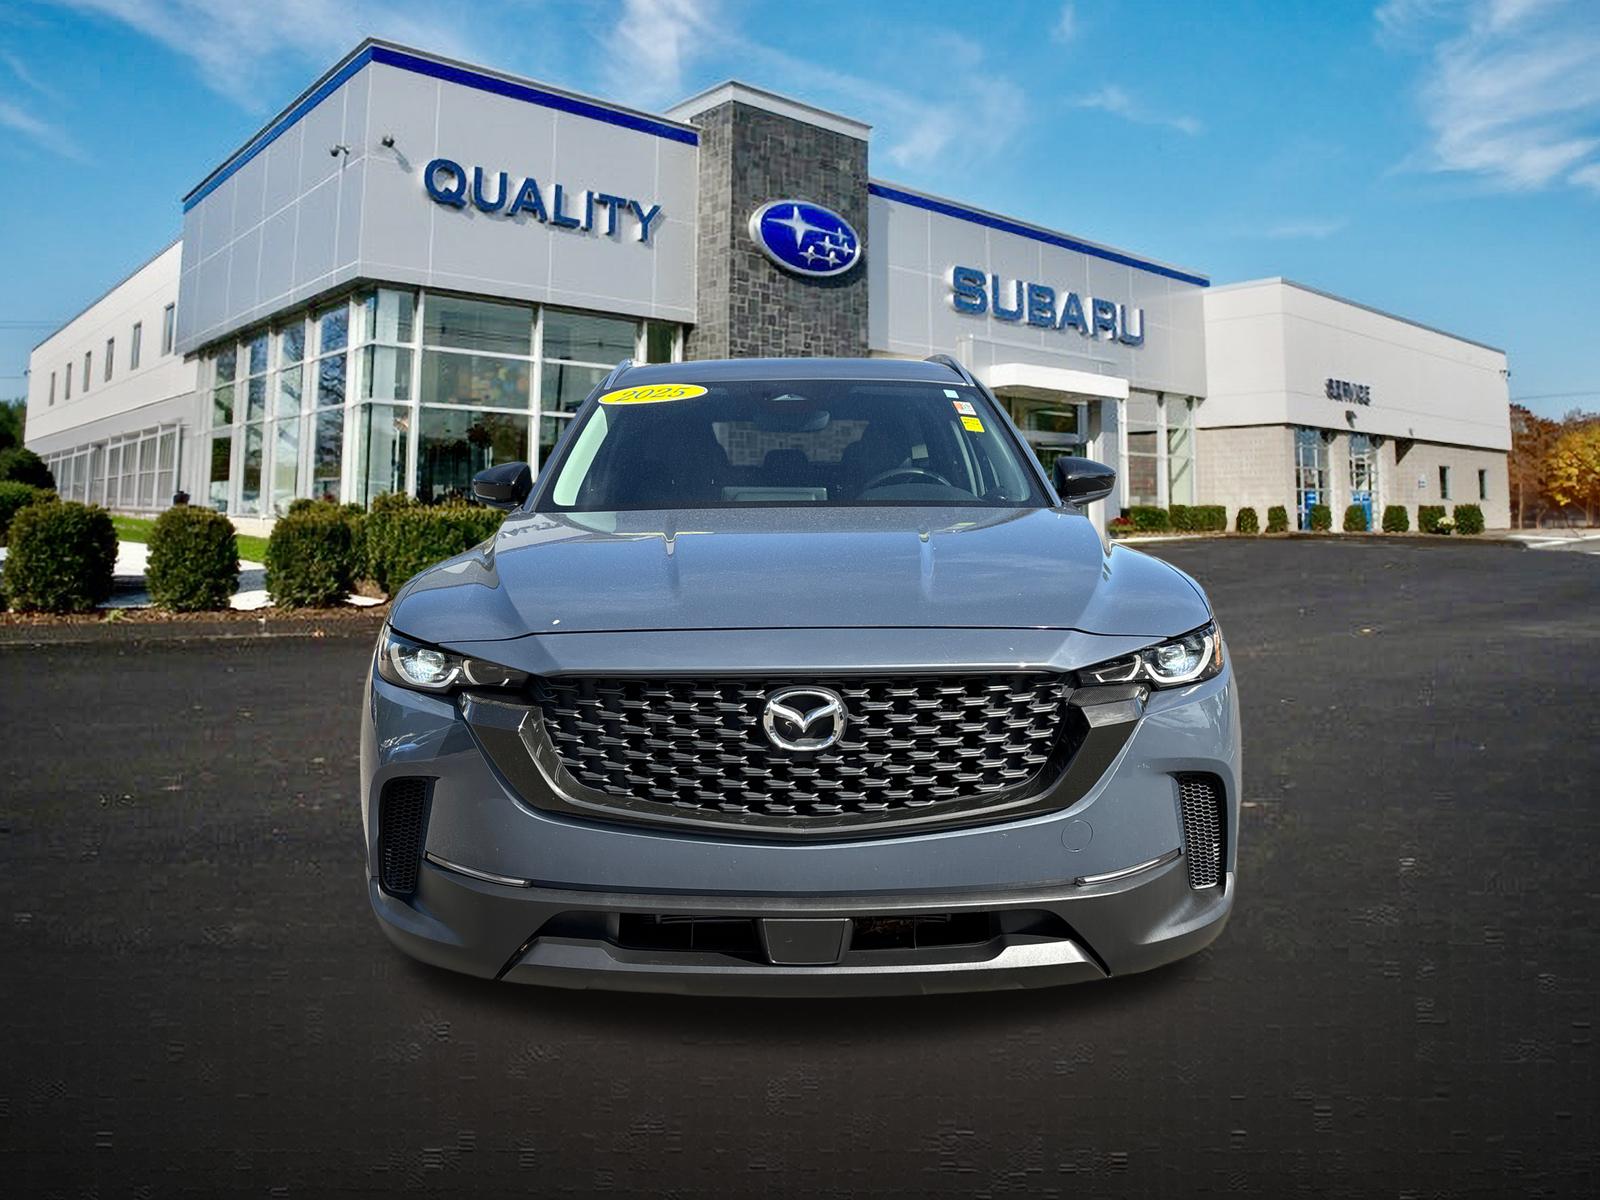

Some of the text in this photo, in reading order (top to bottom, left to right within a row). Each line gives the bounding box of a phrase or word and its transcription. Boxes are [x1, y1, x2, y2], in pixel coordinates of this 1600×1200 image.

[423, 158, 662, 242] QUALITY
[952, 265, 1145, 346] SUBARU
[616, 386, 691, 402] 2025
[1325, 378, 1371, 406] SERVICE
